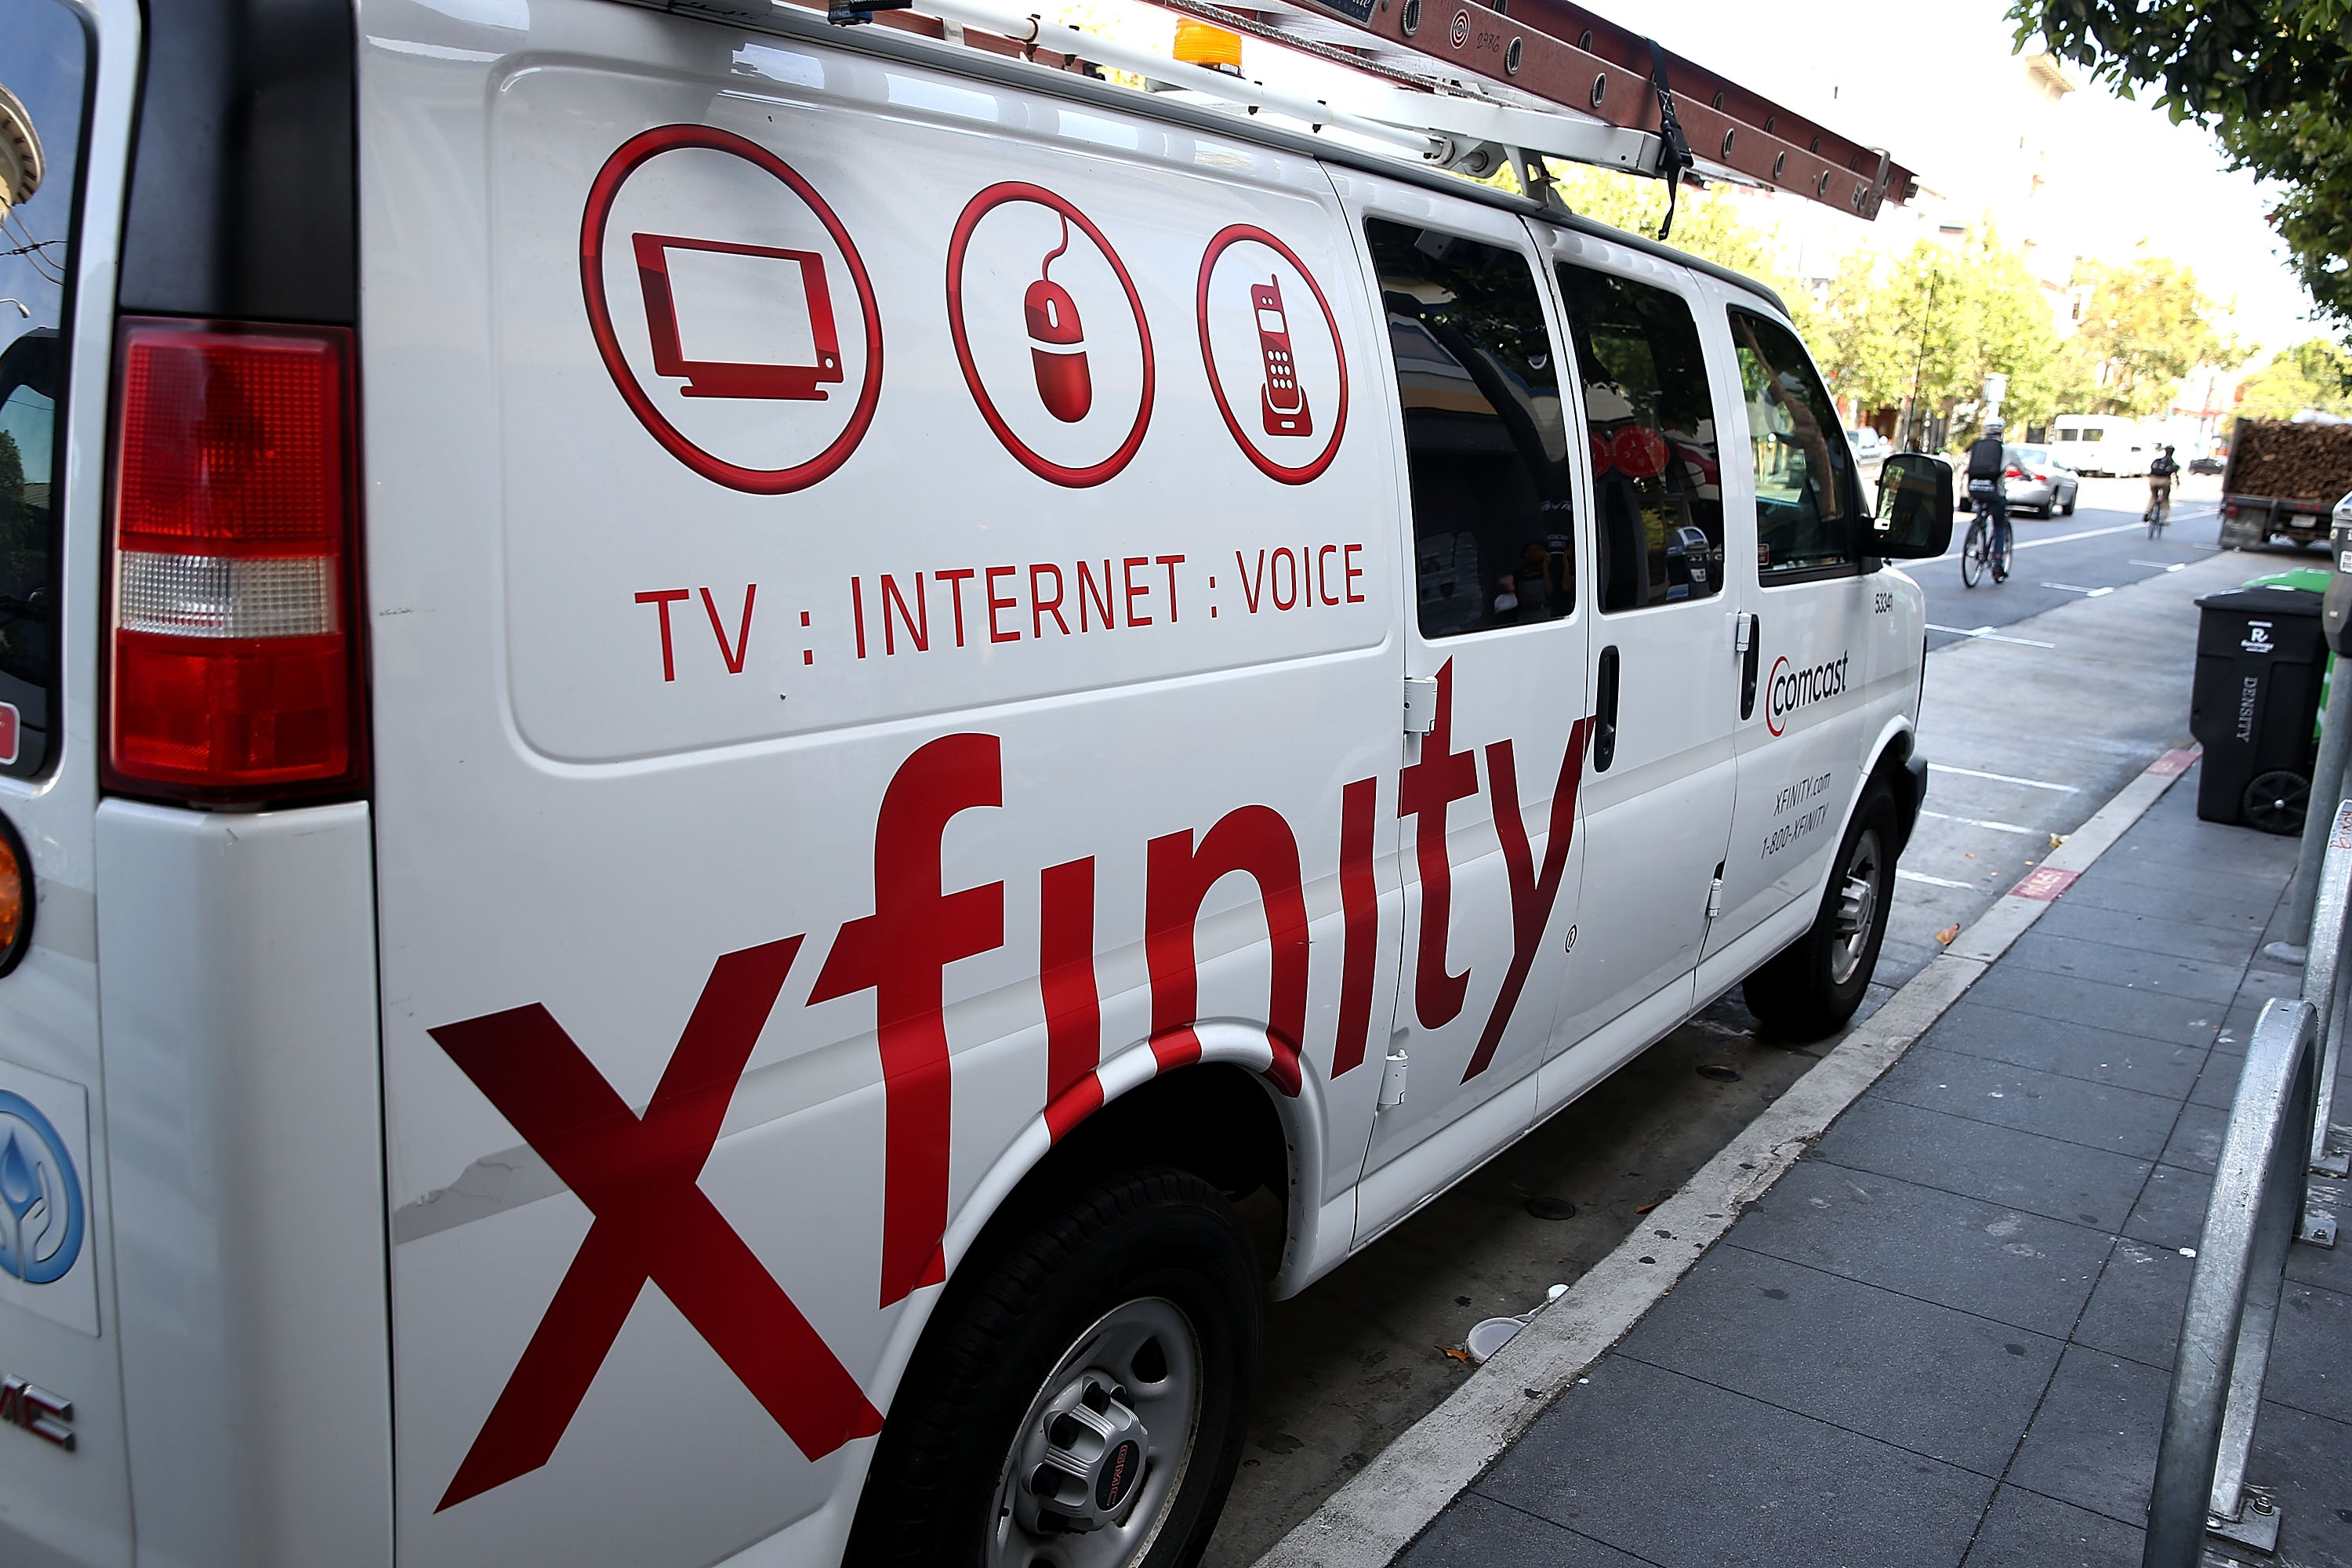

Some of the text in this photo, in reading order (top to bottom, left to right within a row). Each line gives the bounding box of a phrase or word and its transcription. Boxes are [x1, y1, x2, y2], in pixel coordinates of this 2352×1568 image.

[1476, 32, 1501, 53] 2986
[634, 583, 758, 682] TV
[851, 554, 1185, 659] INTERNET
[1236, 543, 1365, 615] VOICE
[2237, 676, 2258, 743] DENSITY
[1773, 772, 1831, 817] XFINITY.com
[1761, 802, 1829, 859] 1-800-XFINITY
[429, 657, 1597, 1511] xfinity
[1106, 1445, 1128, 1506] GMC
